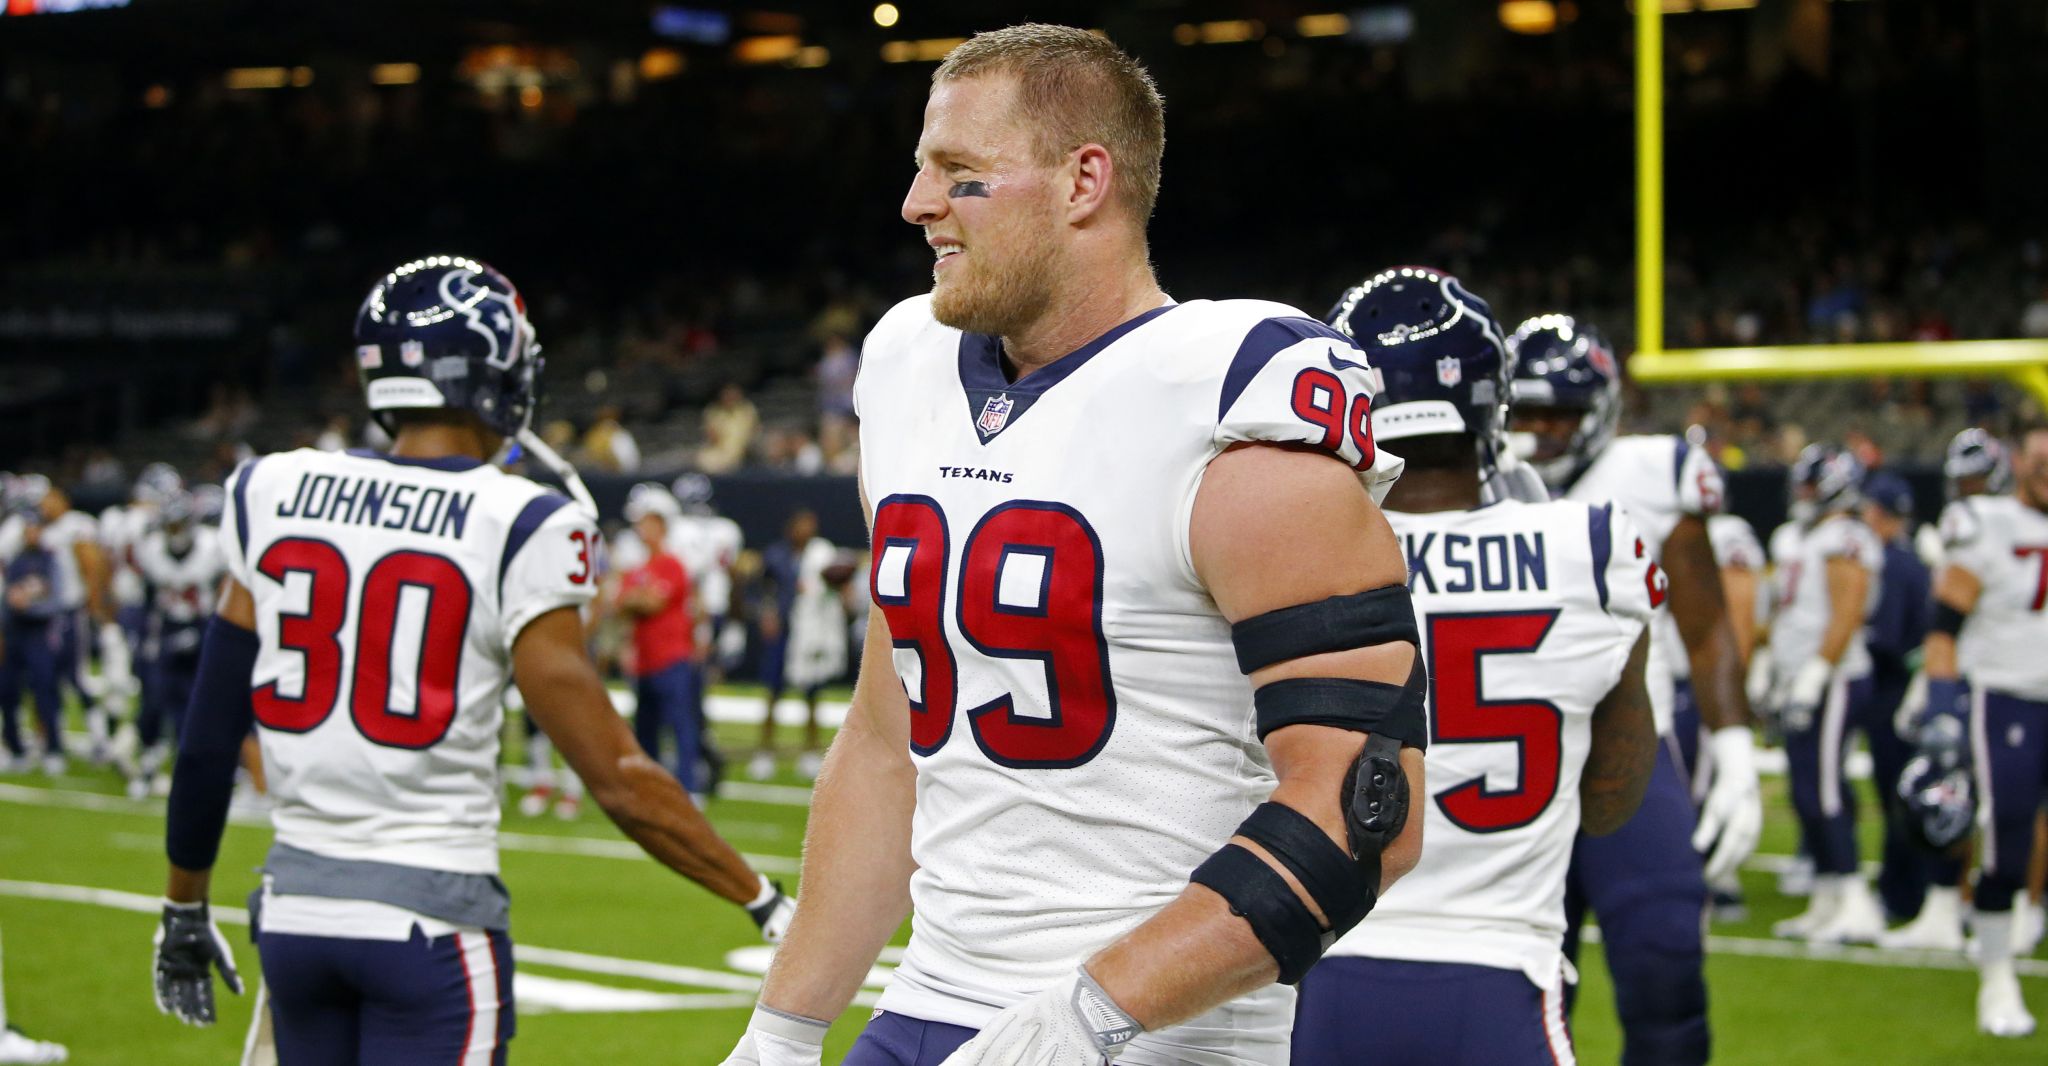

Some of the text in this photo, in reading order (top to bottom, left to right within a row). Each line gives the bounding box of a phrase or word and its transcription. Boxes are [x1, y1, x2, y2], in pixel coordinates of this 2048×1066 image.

[982, 411, 1005, 428] NFL
[1291, 367, 1375, 471] 99
[277, 472, 475, 539] JOHNSON
[939, 466, 1014, 483] TEXANS
[1399, 532, 1548, 594] KSON
[250, 537, 473, 750] 30
[870, 493, 1117, 769] 99
